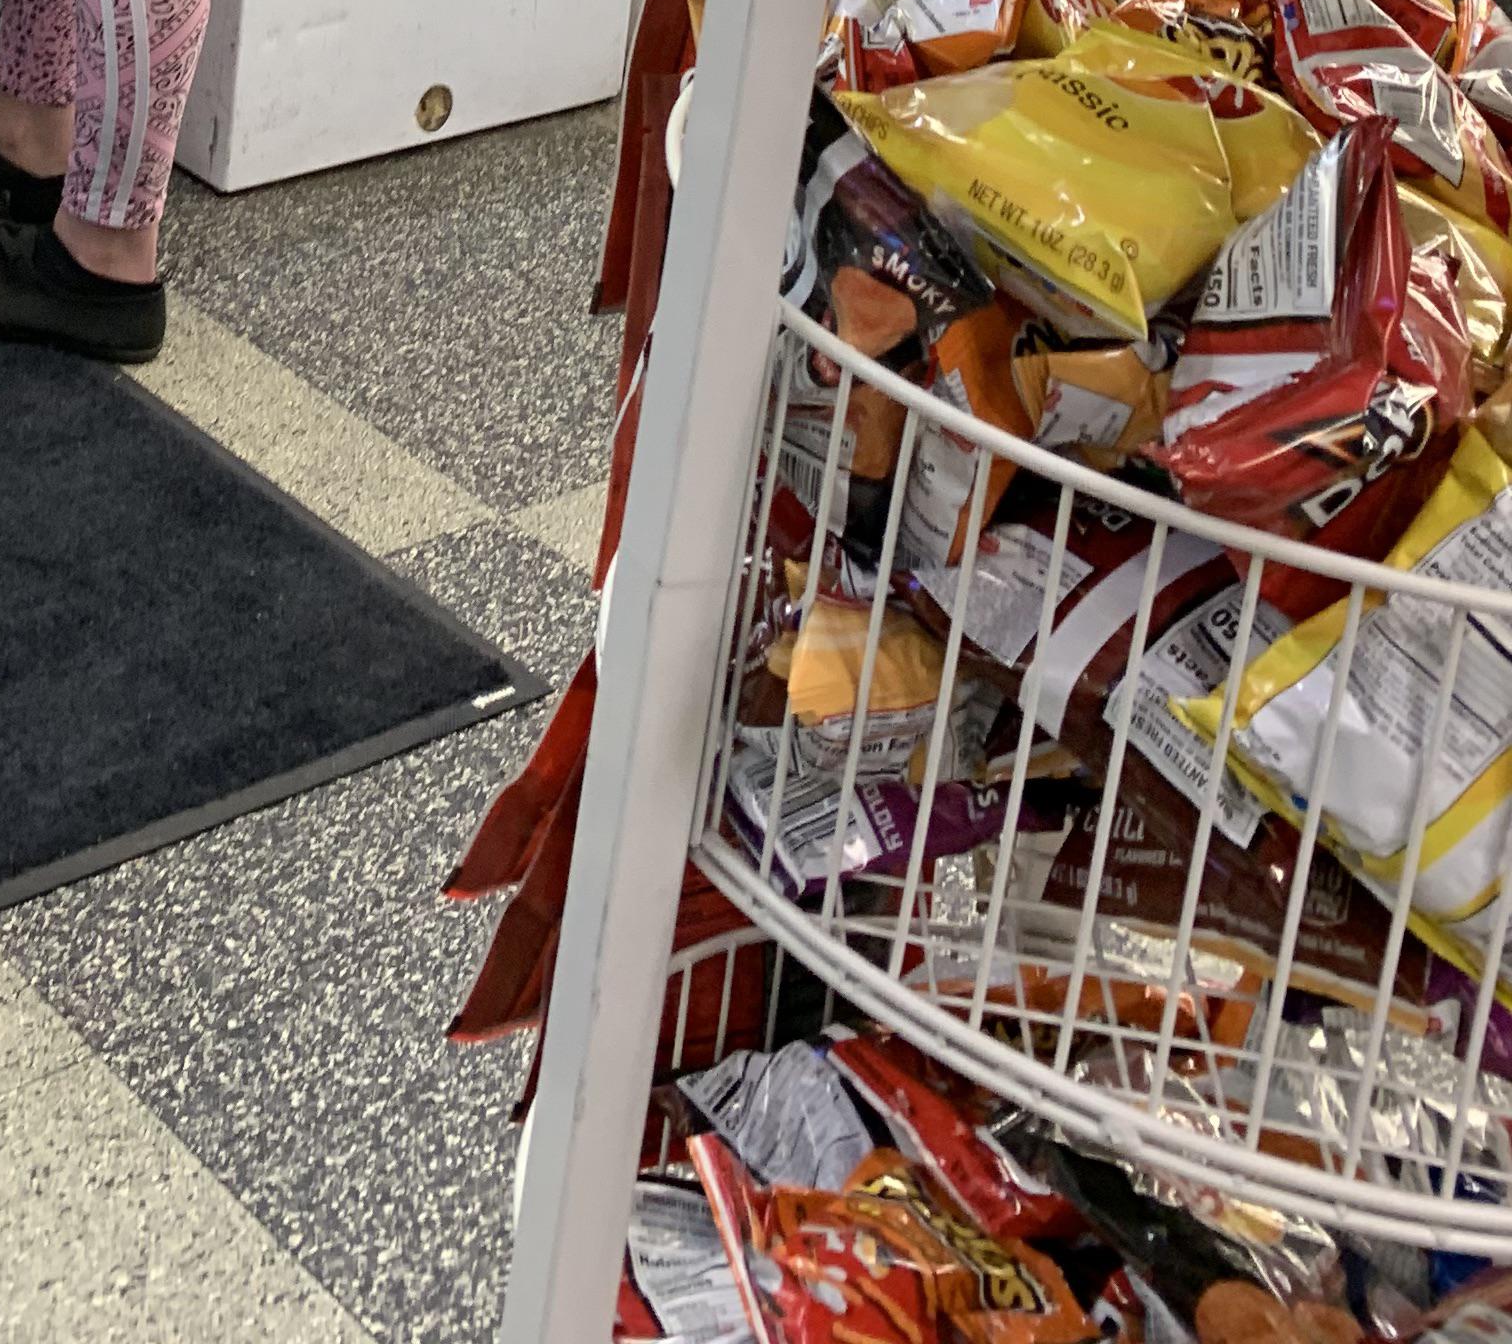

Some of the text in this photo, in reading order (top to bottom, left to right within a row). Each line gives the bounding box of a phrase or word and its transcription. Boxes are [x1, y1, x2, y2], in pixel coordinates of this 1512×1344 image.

[968, 178, 996, 211] NET
[1001, 203, 1026, 229] WT.
[1068, 244, 1110, 283] (28.3
[871, 245, 957, 315] SMOKY
[1203, 266, 1224, 309] 150
[1250, 244, 1265, 307] Facts
